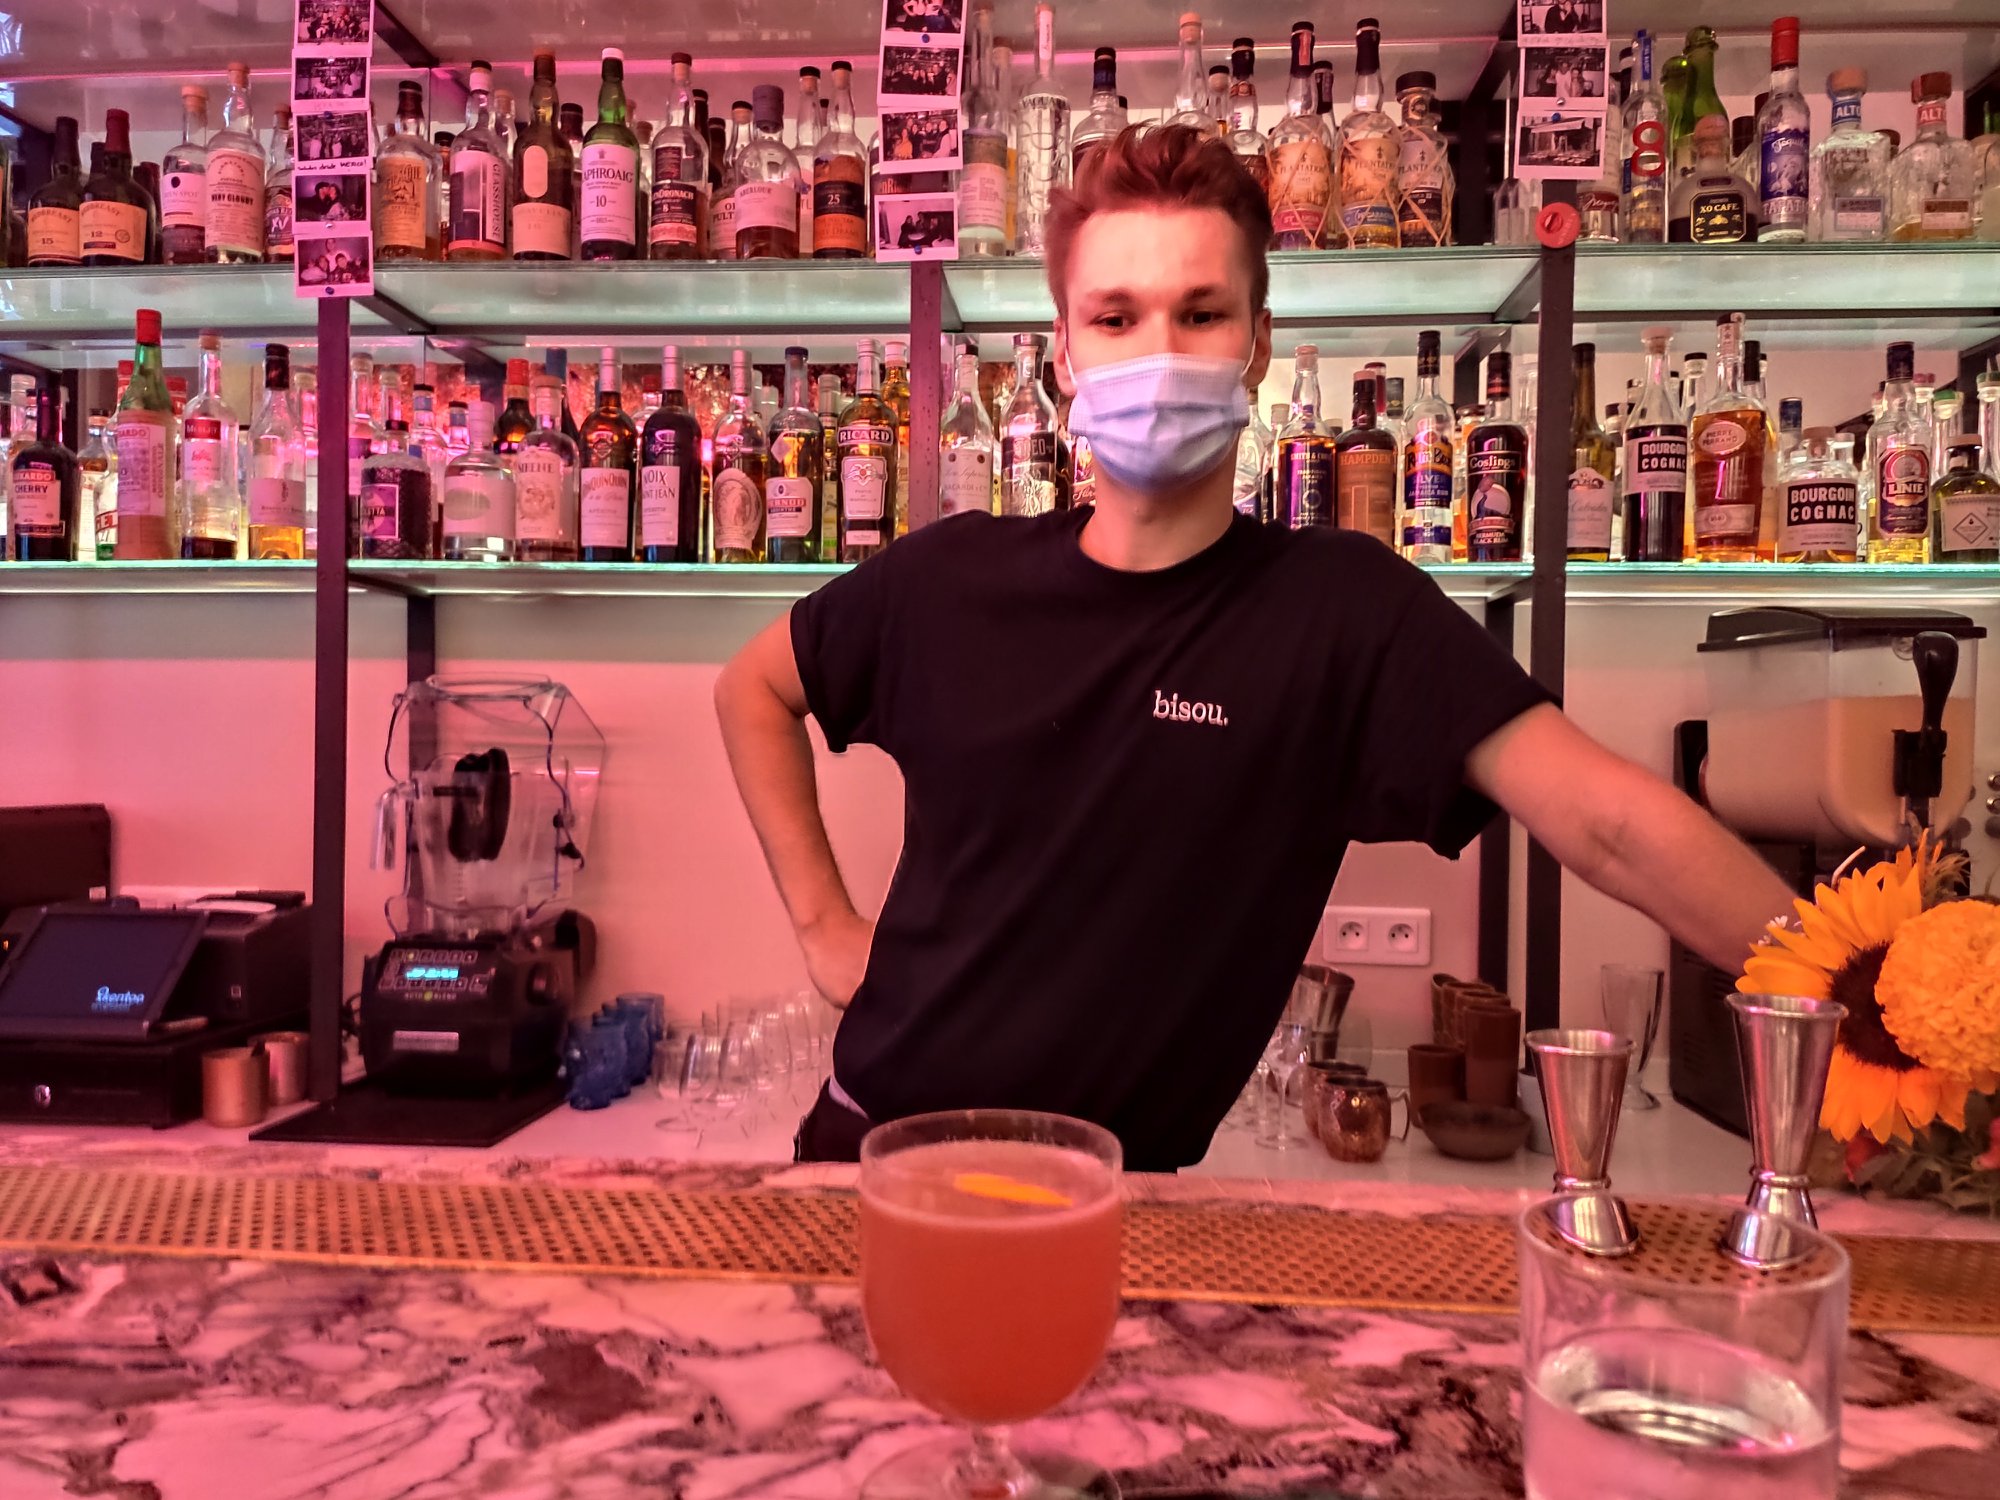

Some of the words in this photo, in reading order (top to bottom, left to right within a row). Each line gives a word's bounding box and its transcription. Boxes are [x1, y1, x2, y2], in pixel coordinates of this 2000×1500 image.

[1632, 121, 1665, 177] 8
[595, 194, 607, 208] 10
[827, 194, 841, 205] 25
[838, 429, 890, 443] RICARD
[15, 485, 48, 493] CHERRY
[655, 487, 676, 500] JEAN
[1888, 483, 1924, 494] LINIE
[1790, 505, 1854, 522] COGNAC
[1153, 689, 1228, 727] bisou.
